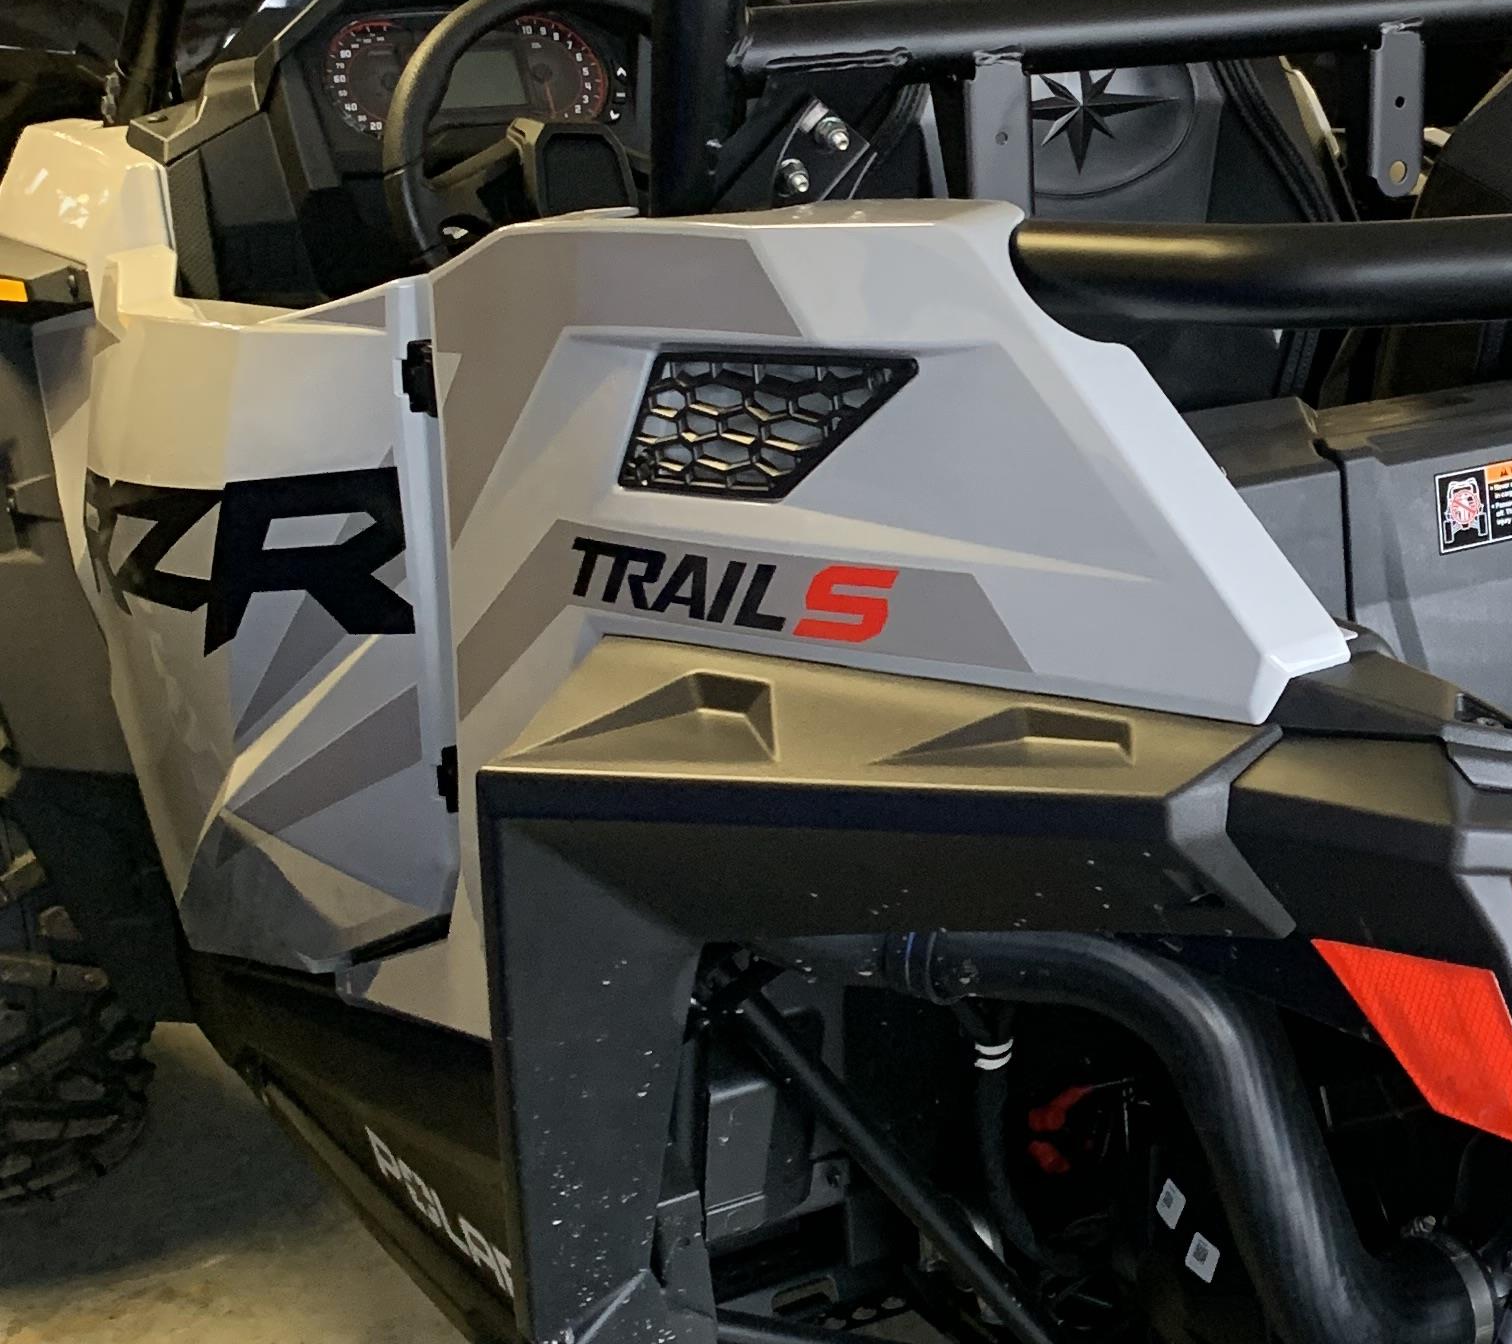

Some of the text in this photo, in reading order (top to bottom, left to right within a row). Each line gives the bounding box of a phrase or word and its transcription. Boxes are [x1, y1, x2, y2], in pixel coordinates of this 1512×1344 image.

[522, 26, 533, 35] 10
[567, 40, 573, 49] 7
[582, 66, 589, 76] 5
[585, 82, 591, 90] 4
[582, 94, 589, 104] 3
[344, 102, 358, 111] 40
[369, 121, 382, 130] 20
[572, 535, 899, 643] TRAIL S
